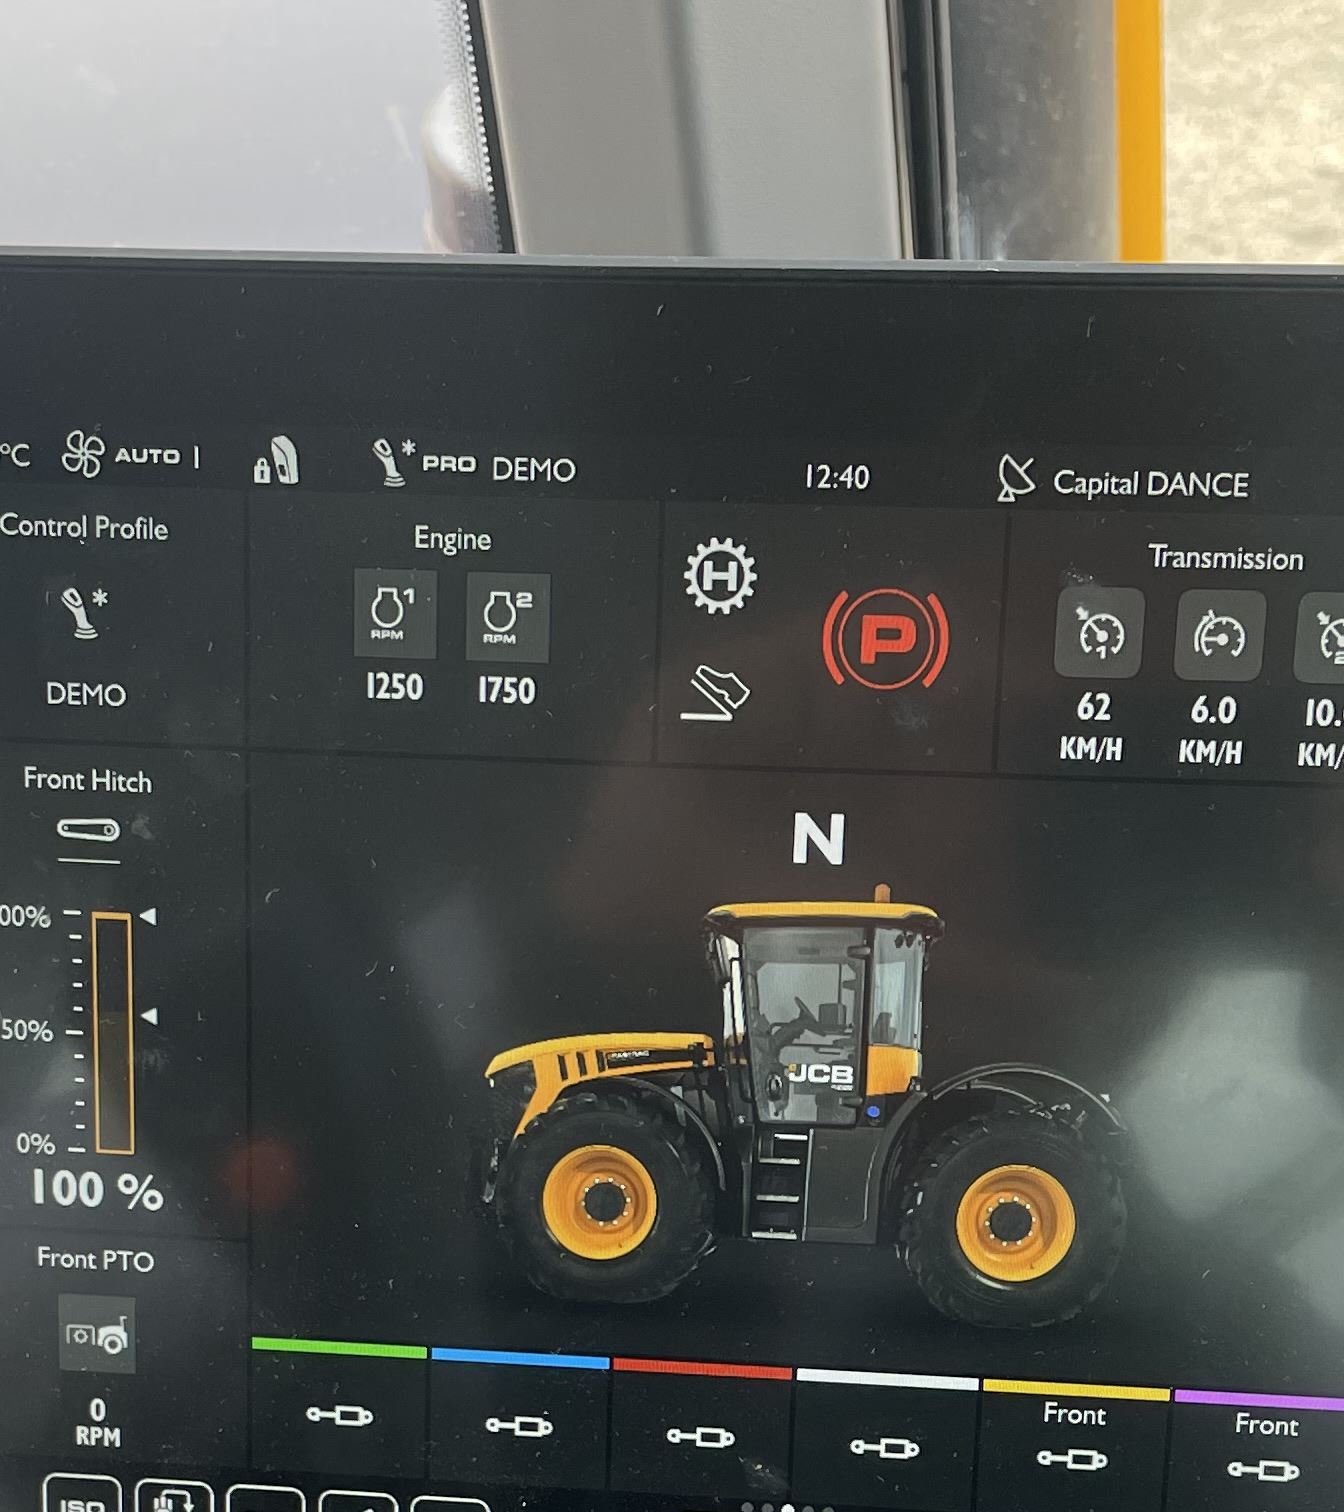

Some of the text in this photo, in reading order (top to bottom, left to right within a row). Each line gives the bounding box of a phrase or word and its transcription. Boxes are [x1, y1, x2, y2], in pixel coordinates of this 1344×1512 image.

[114, 447, 181, 464] AUTO
[422, 455, 576, 483] PRO DEMO
[806, 463, 870, 490] 12:40
[1053, 469, 1250, 501] Capital DANCE
[0, 512, 169, 541] Control Profile
[415, 524, 492, 556] Engine
[1148, 543, 1304, 571] Transmission
[370, 628, 404, 641] RPM
[482, 632, 517, 645] RPM
[47, 681, 127, 707] DEMO
[367, 671, 424, 701] 1250
[479, 675, 536, 705] 1750
[1077, 691, 1111, 721] 62
[1191, 695, 1237, 724] 6.0
[1059, 735, 1123, 763] KM/H
[1178, 739, 1243, 767] KM/H
[24, 765, 152, 793] Front Hitch
[792, 812, 845, 865] N
[1, 1018, 54, 1042] 50%
[789, 1063, 855, 1085] JCB
[16, 1132, 56, 1155] 0%
[33, 1168, 164, 1211] 100 %
[37, 1245, 155, 1273] Front PTO
[89, 1397, 106, 1422] 0
[1043, 1401, 1107, 1426] Front
[76, 1425, 121, 1448] RPM
[1235, 1412, 1300, 1437] Front
